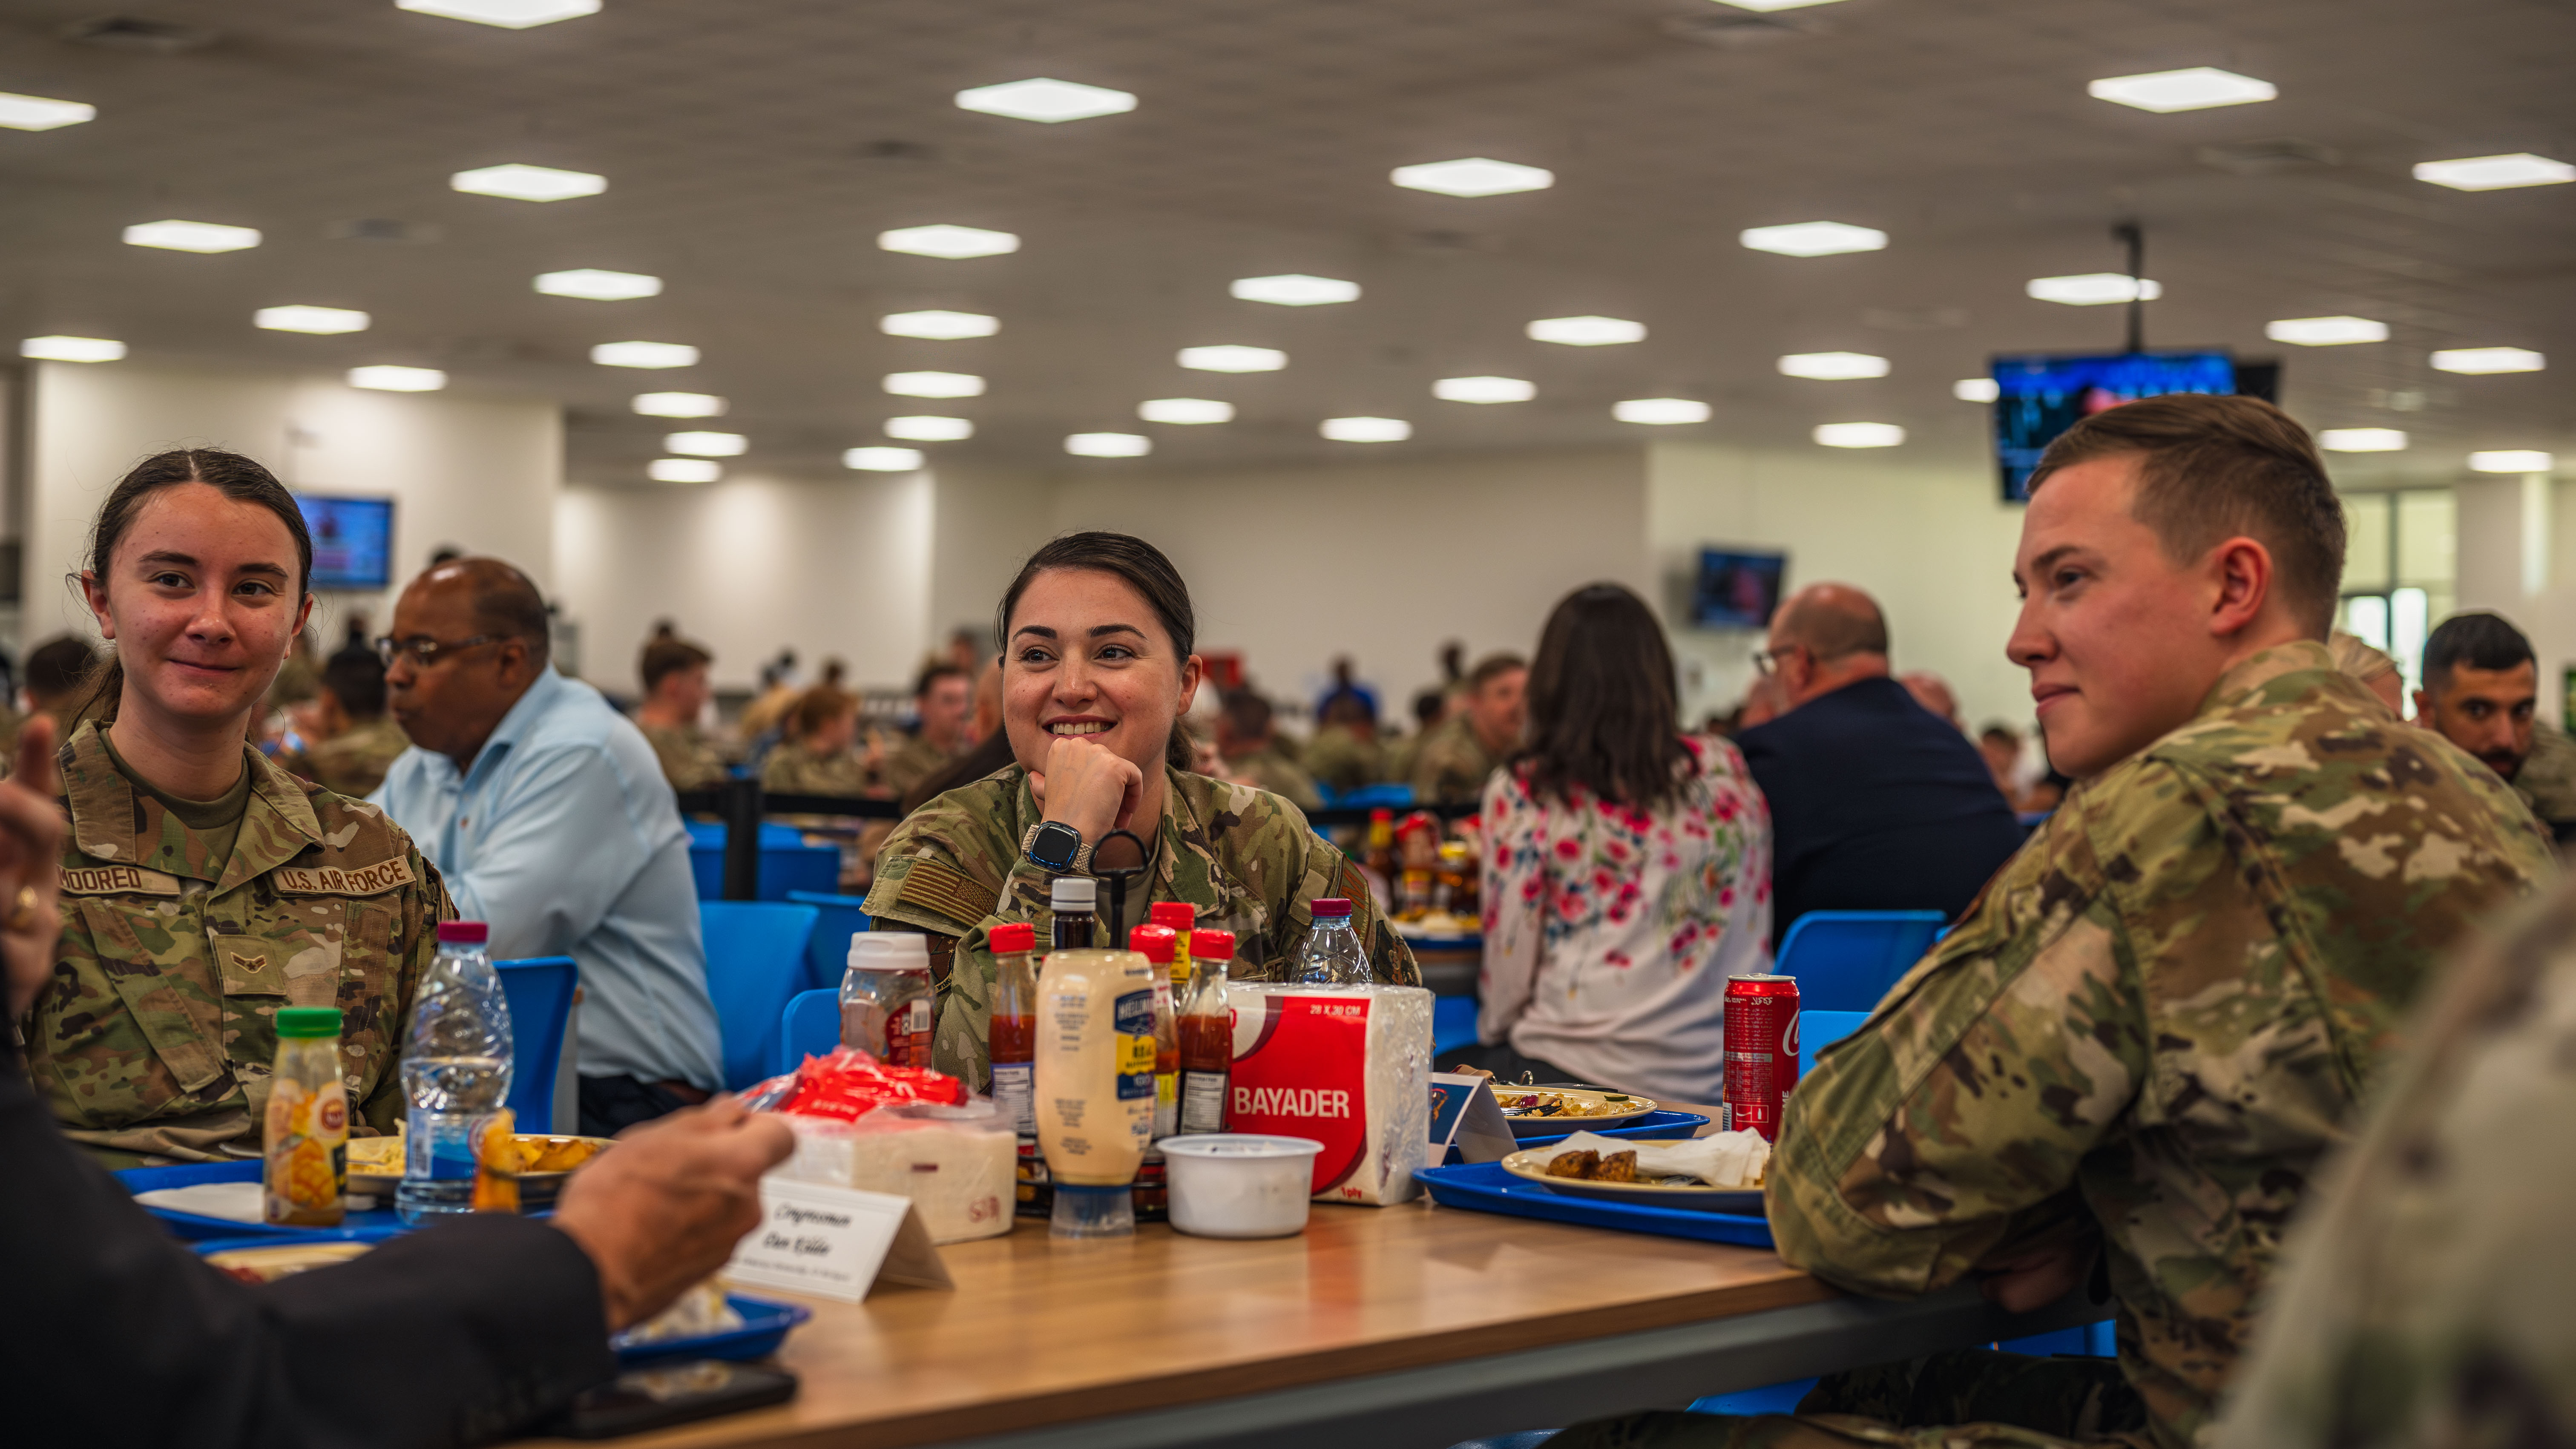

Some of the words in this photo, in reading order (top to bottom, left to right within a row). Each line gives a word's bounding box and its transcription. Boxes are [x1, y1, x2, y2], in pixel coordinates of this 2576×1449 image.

[282, 871, 317, 890] U.S.
[319, 870, 348, 890] AIR
[344, 860, 406, 892] FORCE
[1234, 1087, 1350, 1118] BAYADER
